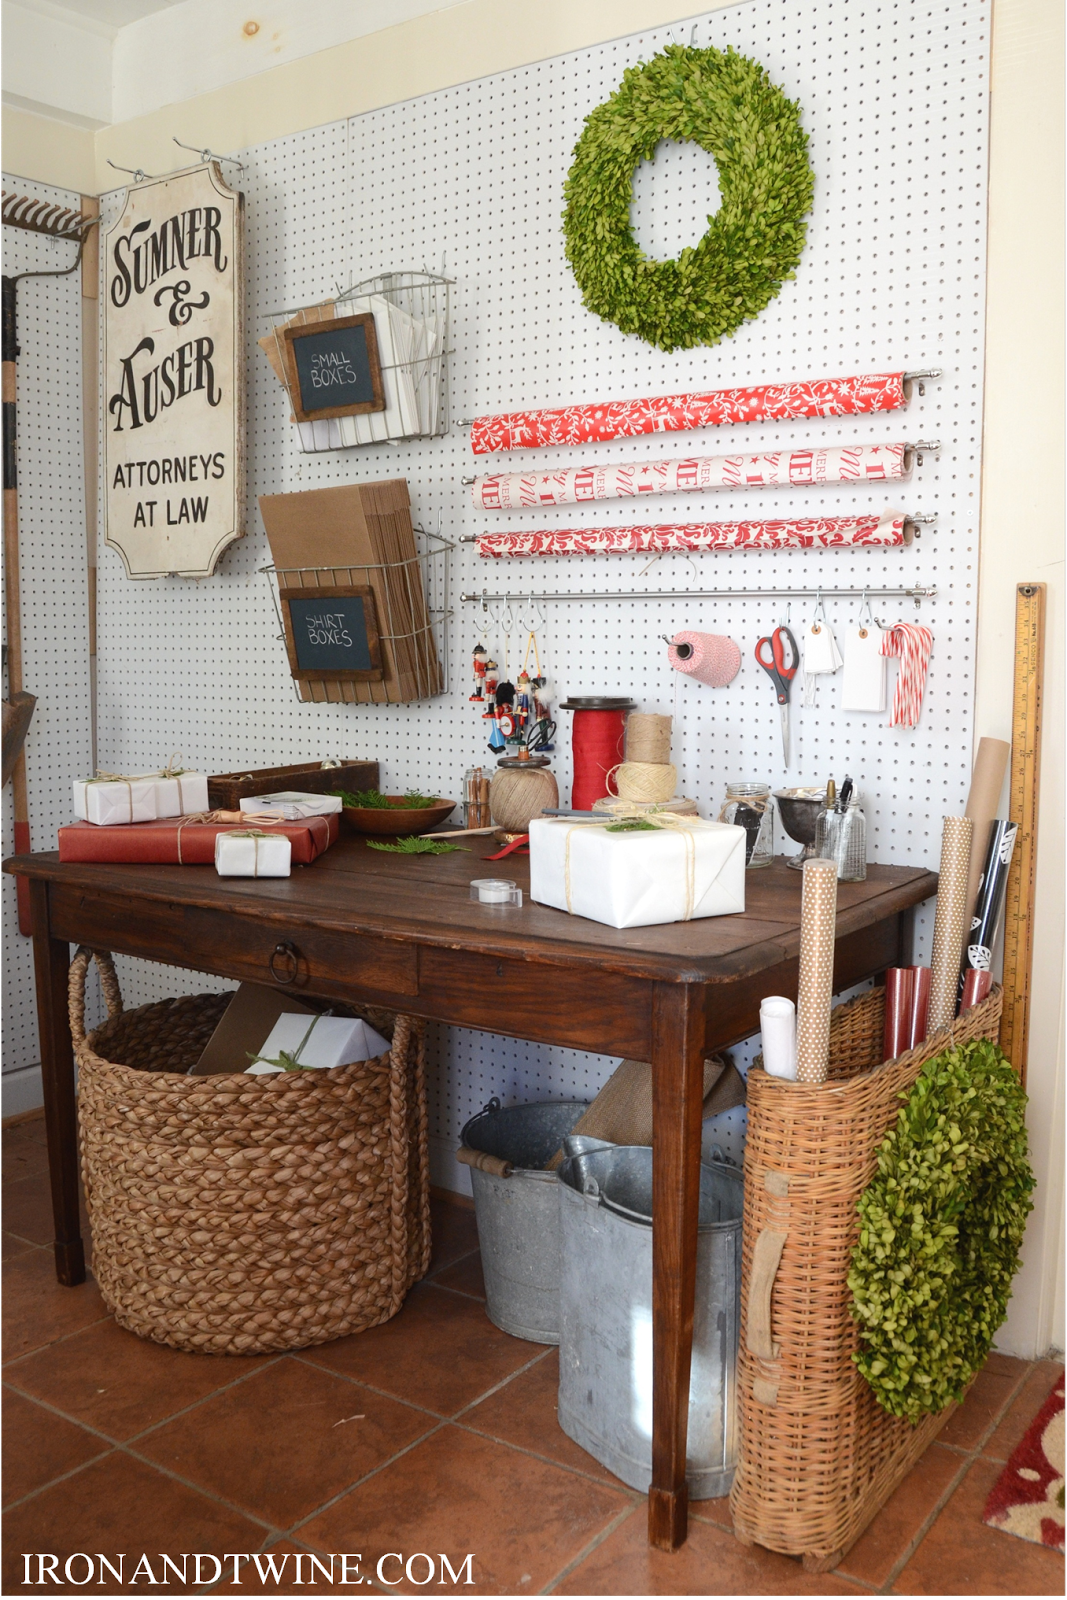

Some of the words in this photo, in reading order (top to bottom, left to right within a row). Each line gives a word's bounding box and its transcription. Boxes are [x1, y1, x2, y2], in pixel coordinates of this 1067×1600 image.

[110, 206, 228, 308] SUMNER
[153, 280, 210, 327] &
[311, 351, 350, 369] SMALL
[311, 365, 357, 388] BOXES
[109, 336, 222, 432] AUSER
[113, 451, 226, 490] ATTORNEYS
[133, 501, 158, 529] AT
[166, 496, 210, 526] LAW
[305, 613, 345, 629] SHIRT
[308, 628, 353, 648] BOXES
